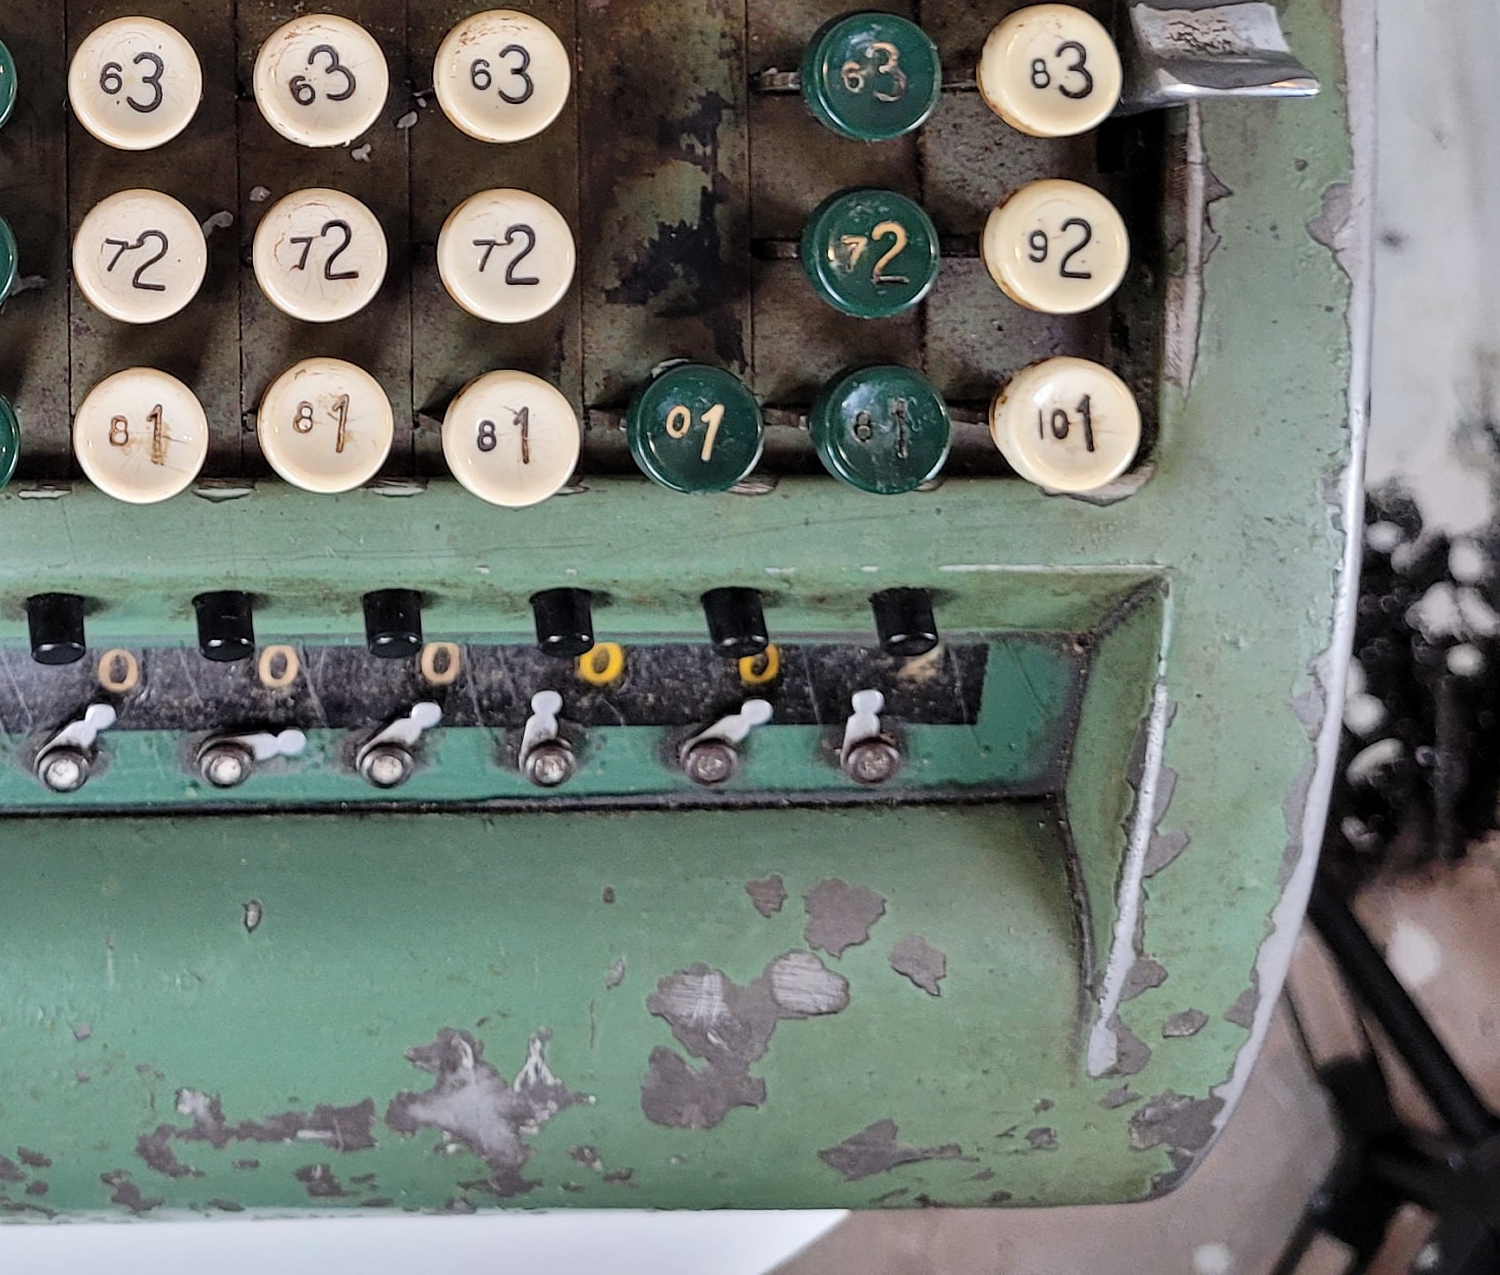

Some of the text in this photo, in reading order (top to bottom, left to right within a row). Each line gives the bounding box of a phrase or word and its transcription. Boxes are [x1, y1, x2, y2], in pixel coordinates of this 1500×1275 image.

[99, 51, 164, 114] 63
[469, 44, 535, 105] 63
[1030, 40, 1094, 100] 83
[103, 229, 169, 292] 72
[289, 219, 359, 281] 72
[472, 223, 540, 286] 72
[1028, 217, 1092, 280] 92
[108, 403, 166, 466] 81
[293, 393, 350, 454] 81
[476, 405, 530, 465] 81
[100, 648, 139, 691] 0
[258, 645, 298, 688] 0
[421, 641, 460, 686] 0
[578, 641, 625, 686] 0
